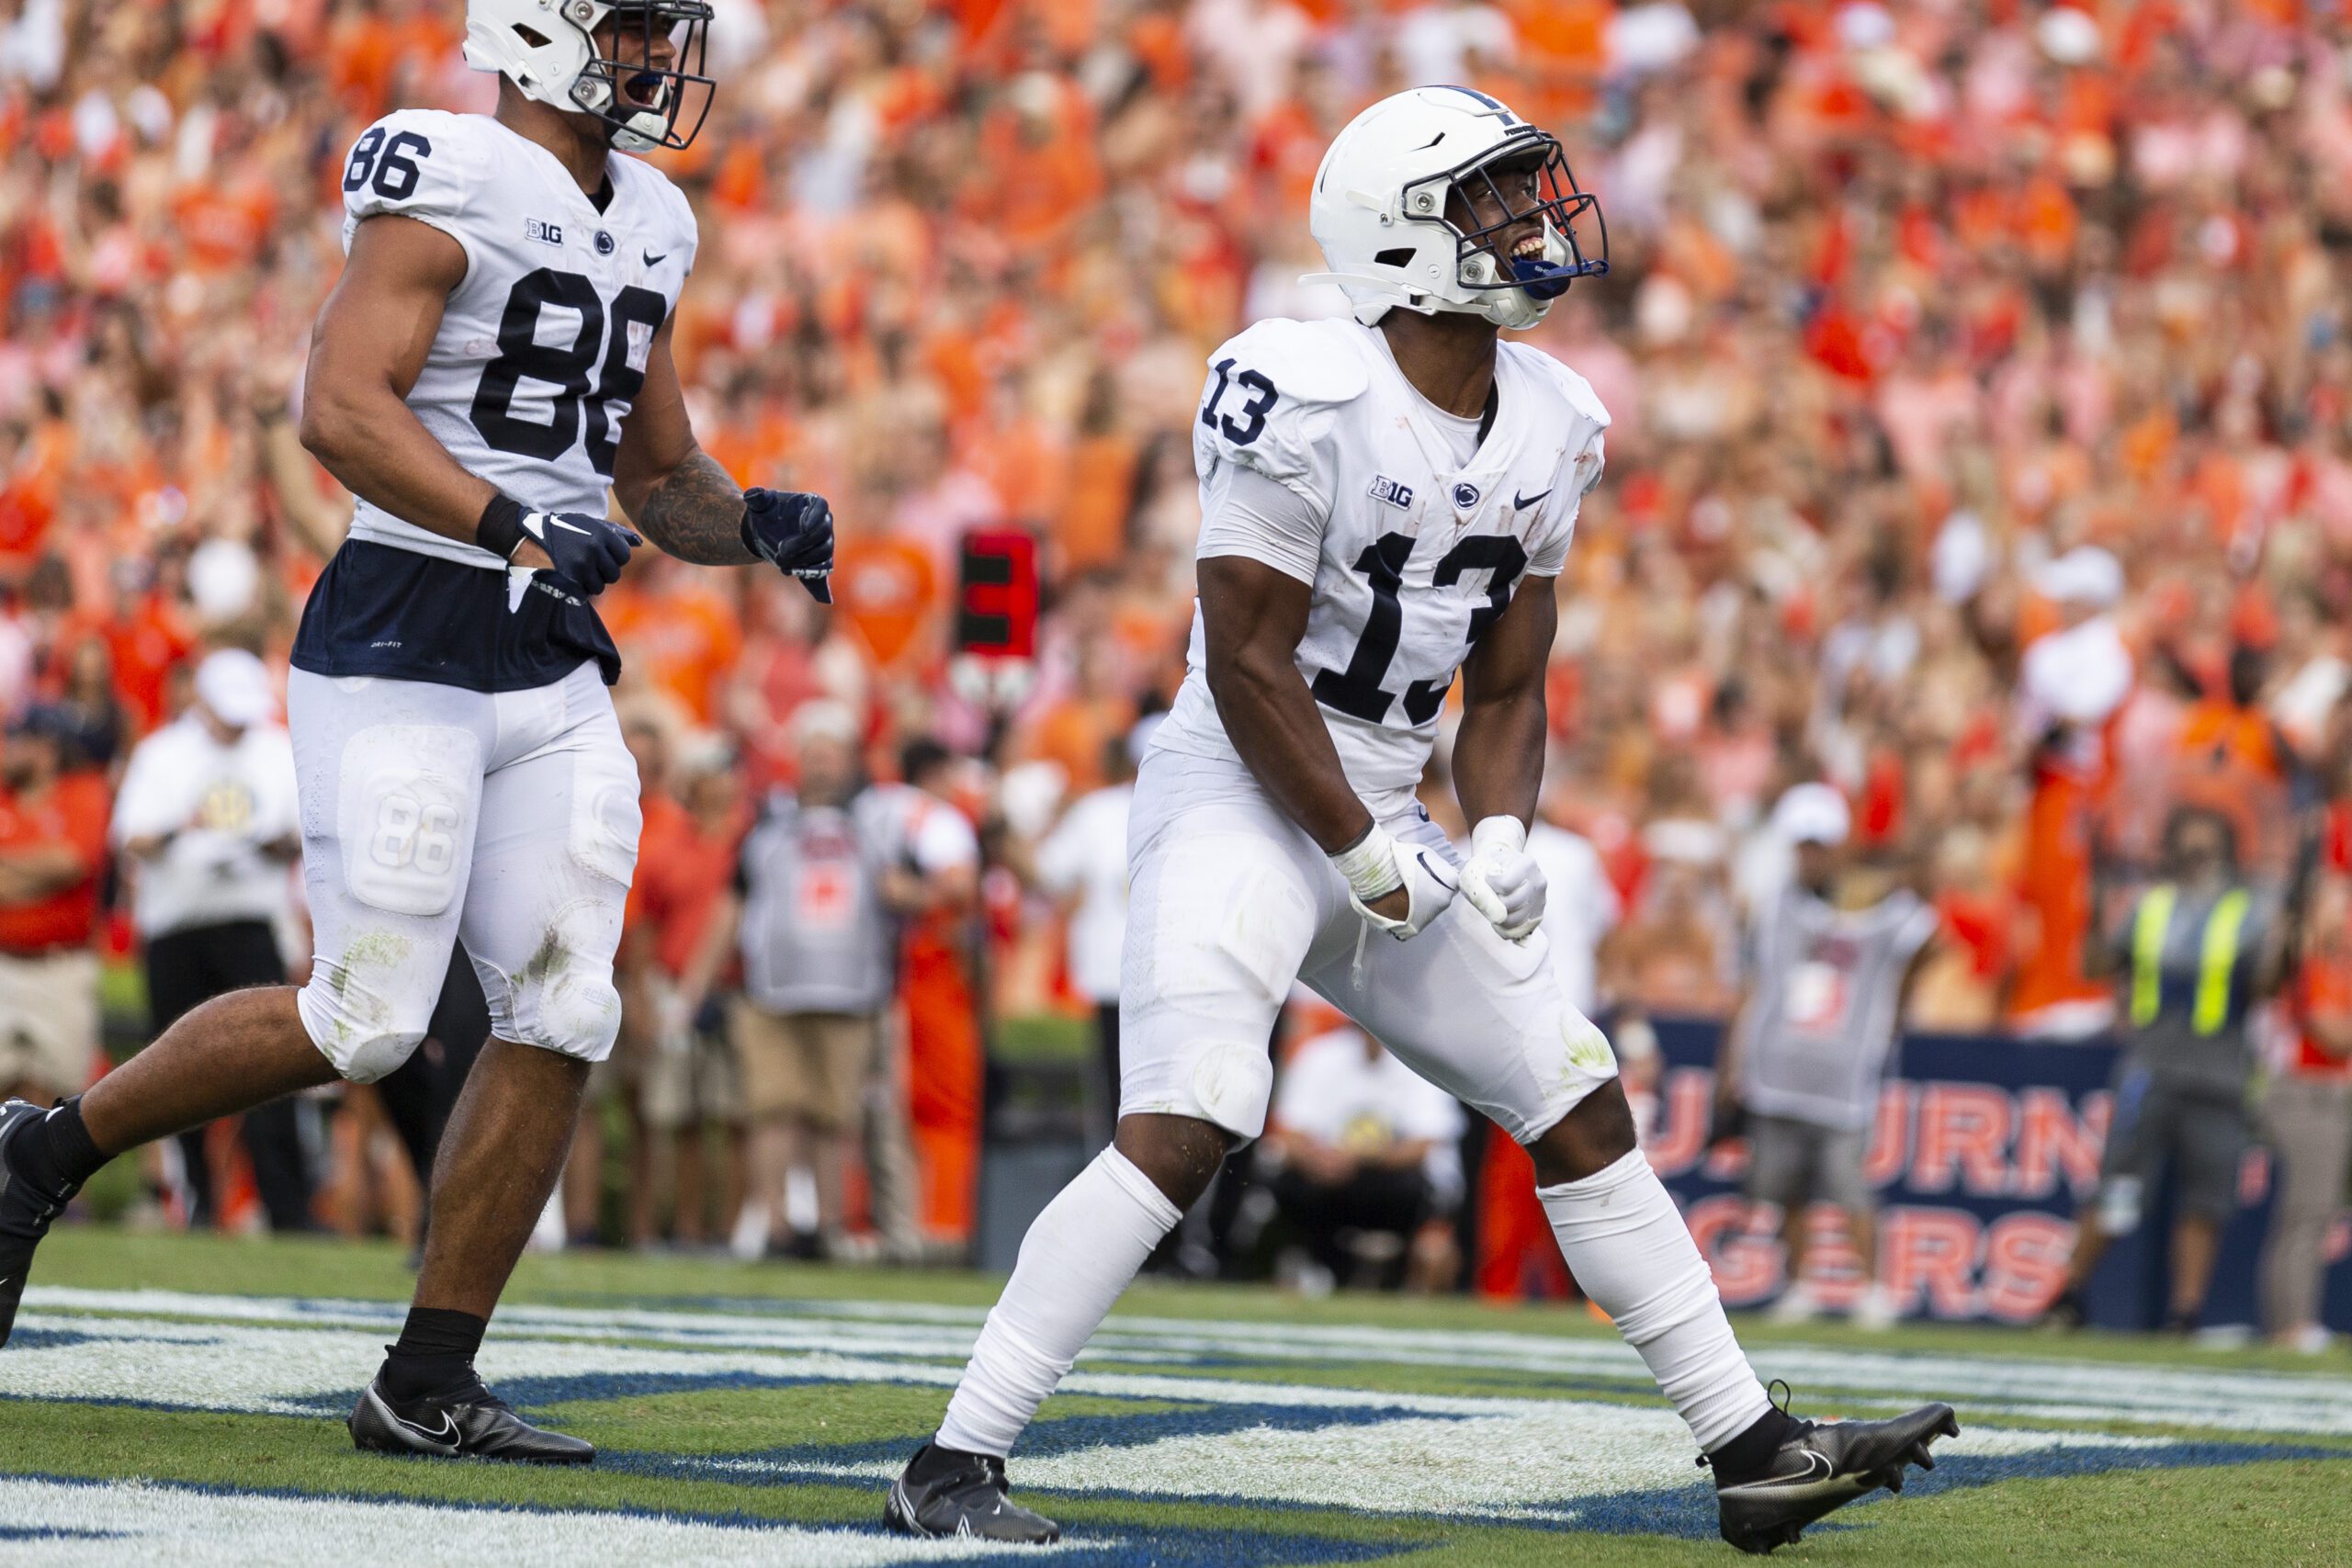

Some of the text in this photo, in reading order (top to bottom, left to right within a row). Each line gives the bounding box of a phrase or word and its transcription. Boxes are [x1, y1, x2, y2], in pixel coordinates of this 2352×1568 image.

[343, 127, 431, 201] 86
[469, 266, 667, 479] 86
[1201, 357, 1279, 446] 13
[1310, 531, 1529, 727] 13
[371, 795, 459, 876] 86
